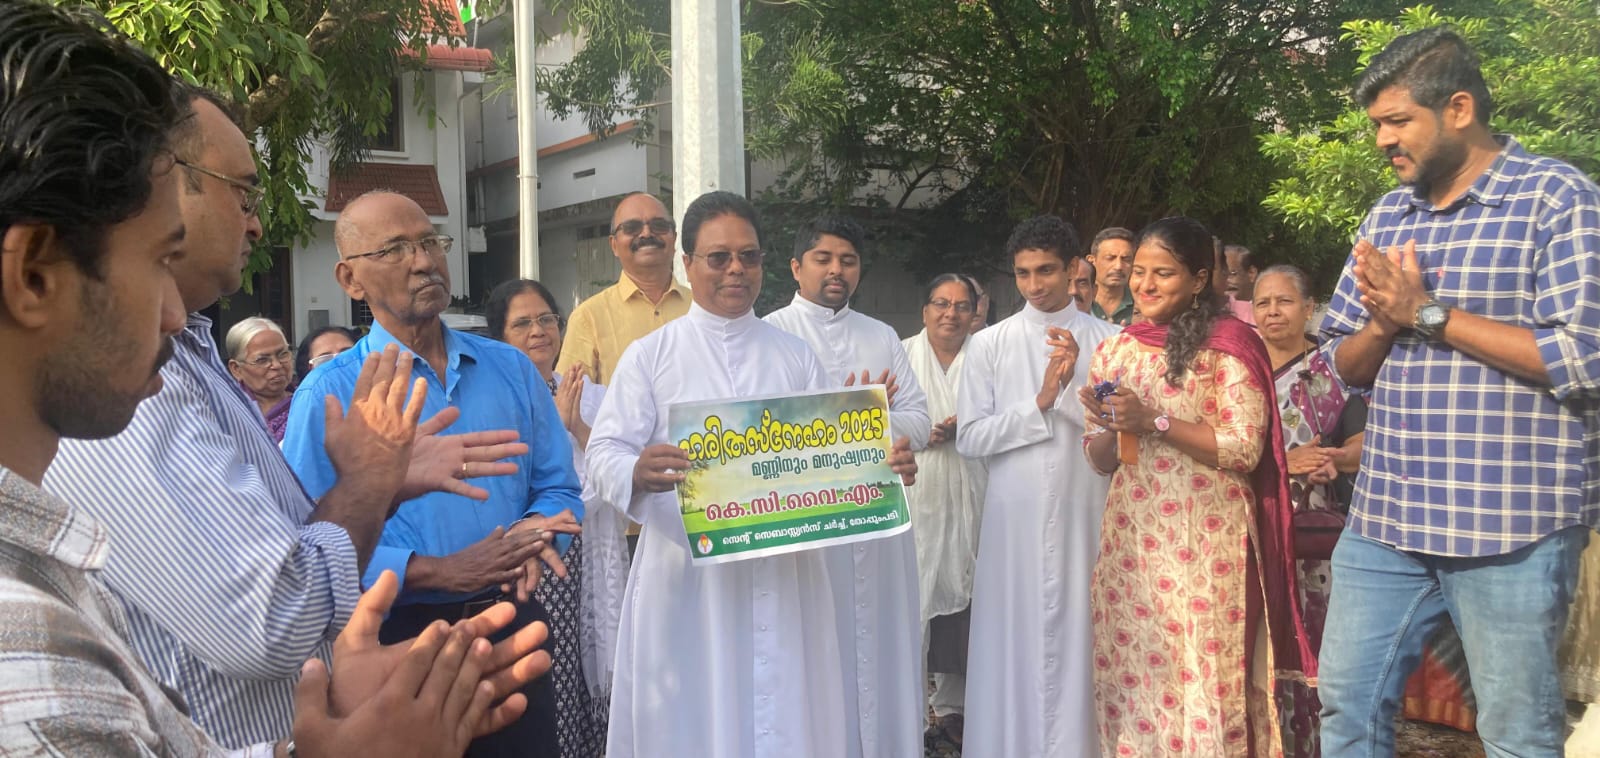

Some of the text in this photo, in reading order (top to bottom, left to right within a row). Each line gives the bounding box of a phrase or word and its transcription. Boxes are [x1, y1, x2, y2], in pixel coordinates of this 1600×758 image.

[678, 407, 884, 465] ഹരിതസ്നേഹം 2025
[752, 447, 886, 479] മണ്ണിനും മനുഷ്യനും
[706, 484, 883, 521] കെ.സി.വൈ.എം.
